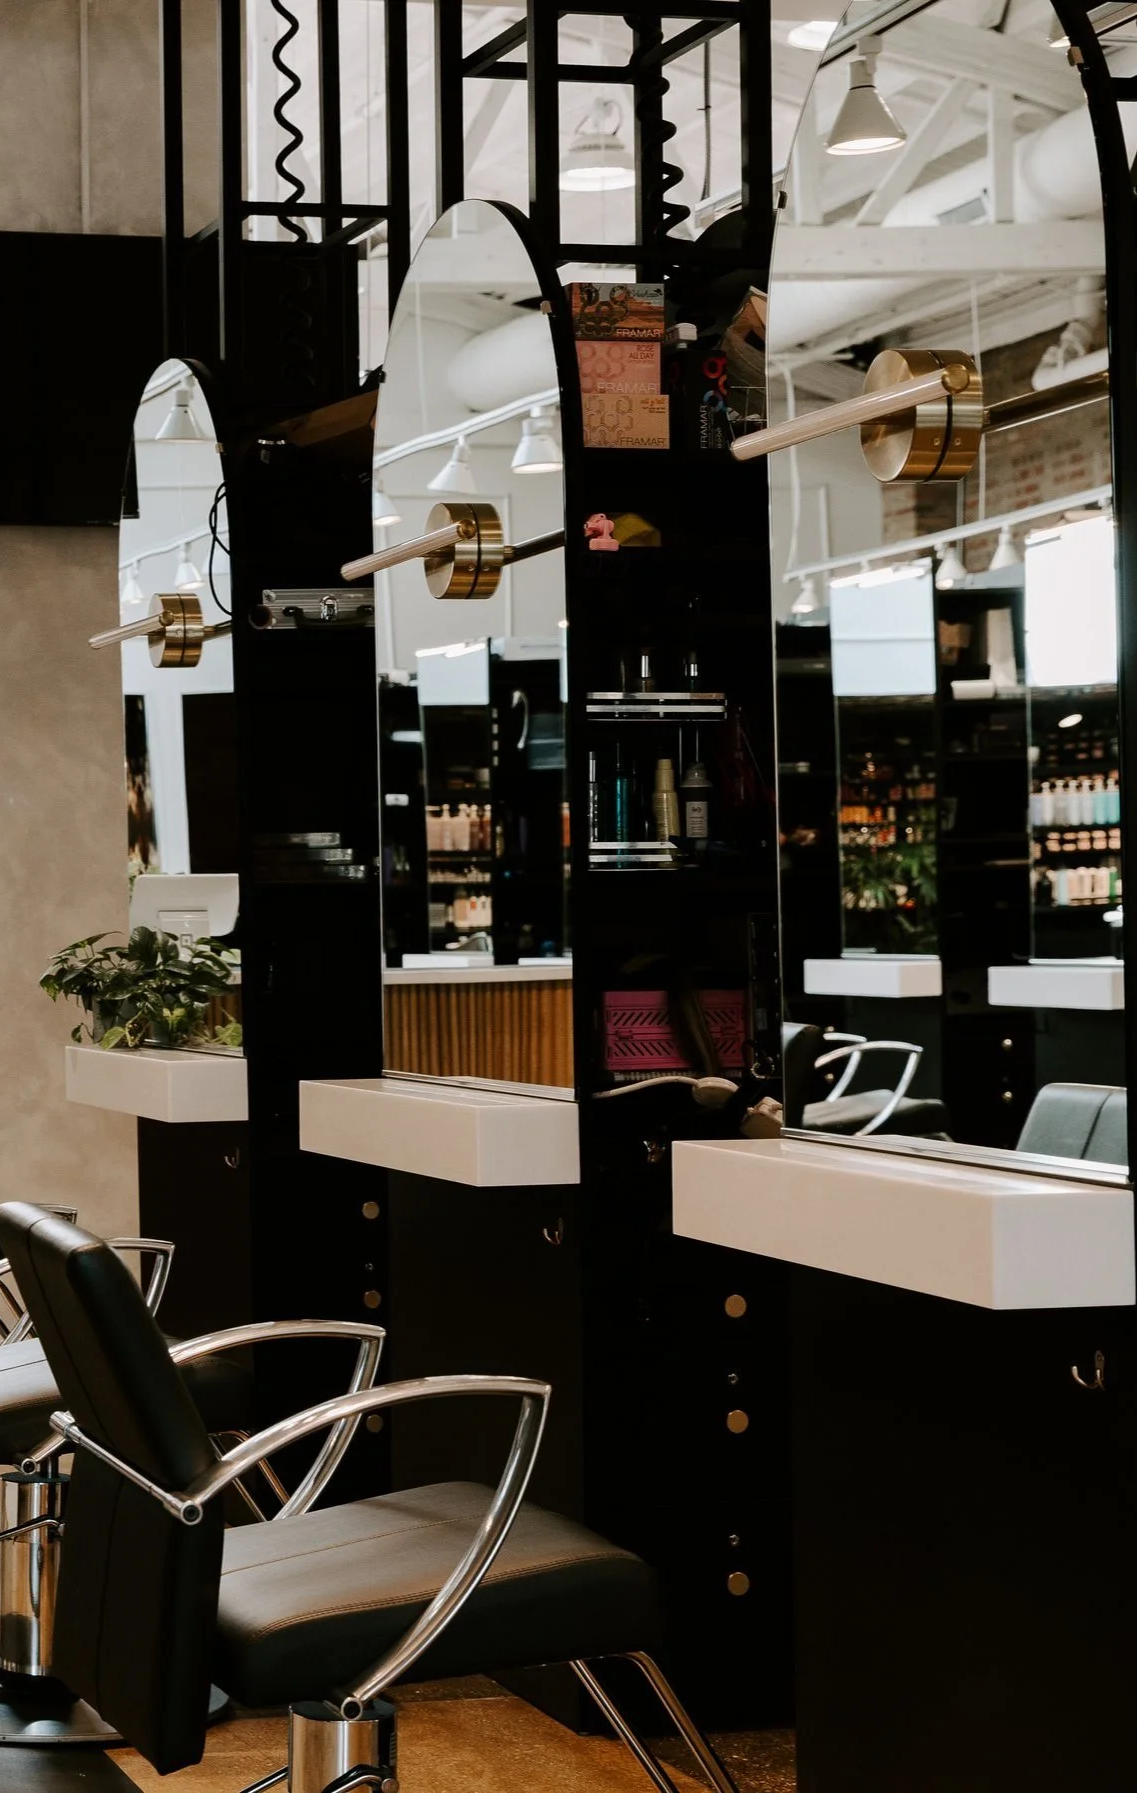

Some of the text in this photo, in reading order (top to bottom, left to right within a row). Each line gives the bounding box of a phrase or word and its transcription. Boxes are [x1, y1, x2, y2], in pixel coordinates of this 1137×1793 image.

[616, 328, 661, 338] FRAMAR
[640, 352, 655, 360] DAY
[597, 381, 656, 394] FRAMAR
[700, 405, 708, 449] FRAMAR
[620, 436, 666, 447] FRAMAR
